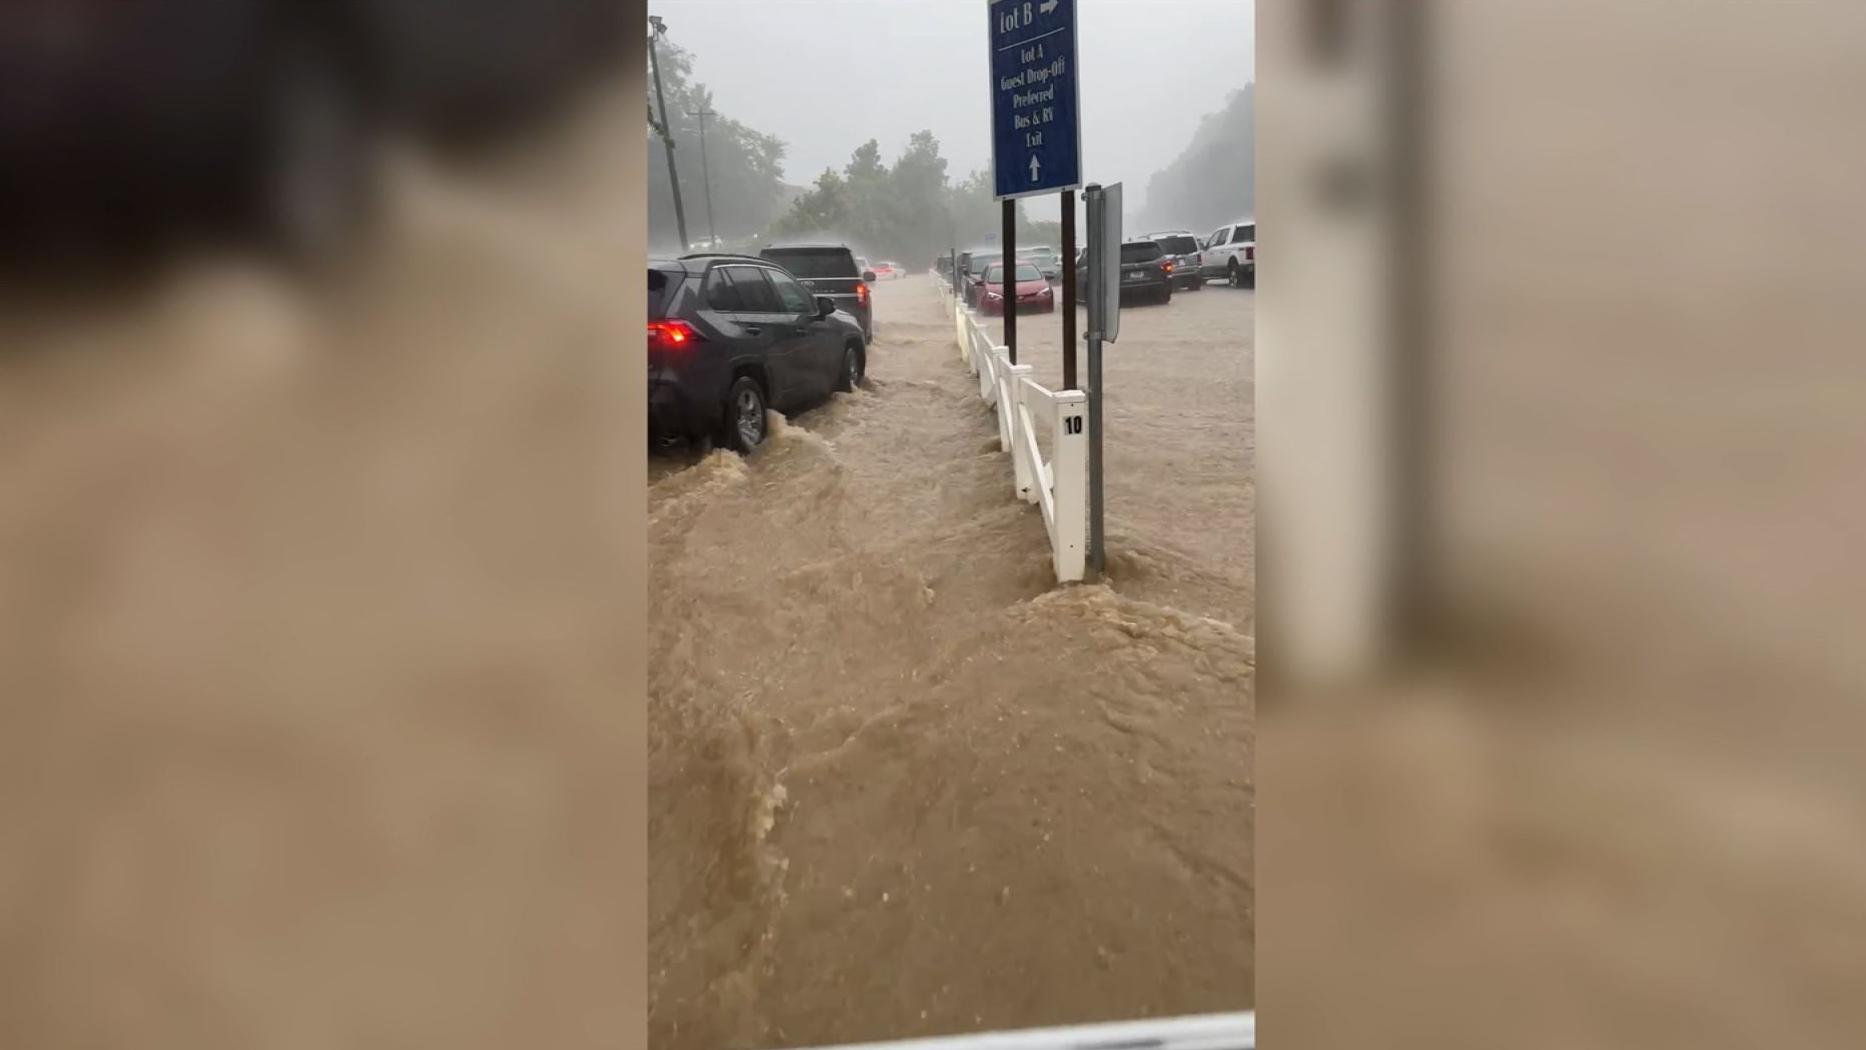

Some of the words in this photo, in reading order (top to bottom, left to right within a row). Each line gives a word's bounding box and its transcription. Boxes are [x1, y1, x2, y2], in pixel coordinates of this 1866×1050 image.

[1000, 8, 1020, 33] Lot
[1023, 1, 1033, 25] B
[1021, 45, 1035, 64] Lot
[1036, 43, 1043, 59] A
[1001, 73, 1025, 91] Guest
[1027, 56, 1065, 84] Drop-Off
[1013, 85, 1054, 109] Preferred
[1014, 113, 1030, 130] Bus
[1032, 111, 1041, 125] &
[1043, 107, 1054, 123] RV
[1026, 131, 1043, 148] Exit
[1065, 415, 1082, 435] 10
